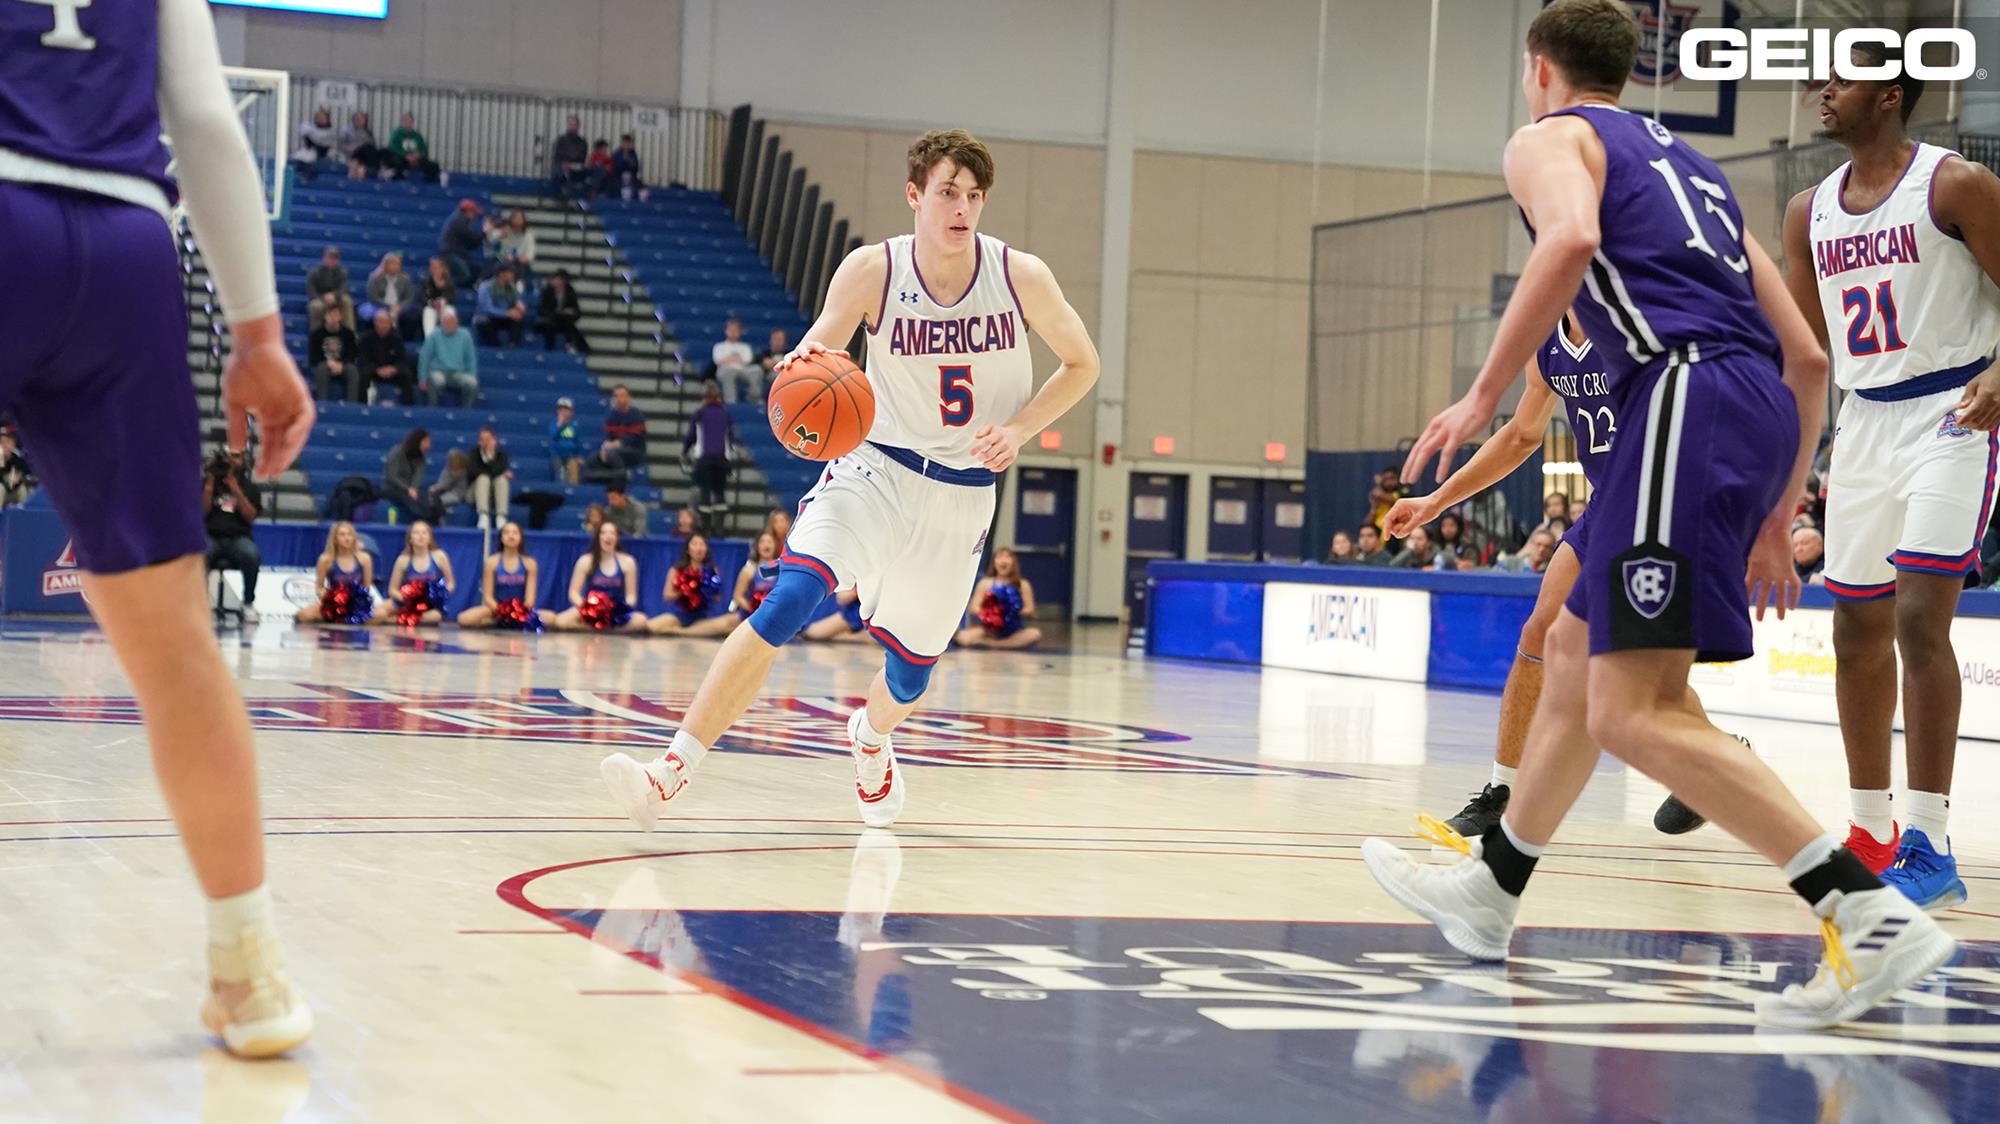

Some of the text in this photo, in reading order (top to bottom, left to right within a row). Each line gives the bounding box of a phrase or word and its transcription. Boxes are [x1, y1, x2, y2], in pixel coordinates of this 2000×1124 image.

[1817, 223, 1920, 280] AMERICAN
[890, 311, 1016, 356] AMERICAN
[1842, 280, 1908, 357] 21
[938, 365, 974, 427] 5
